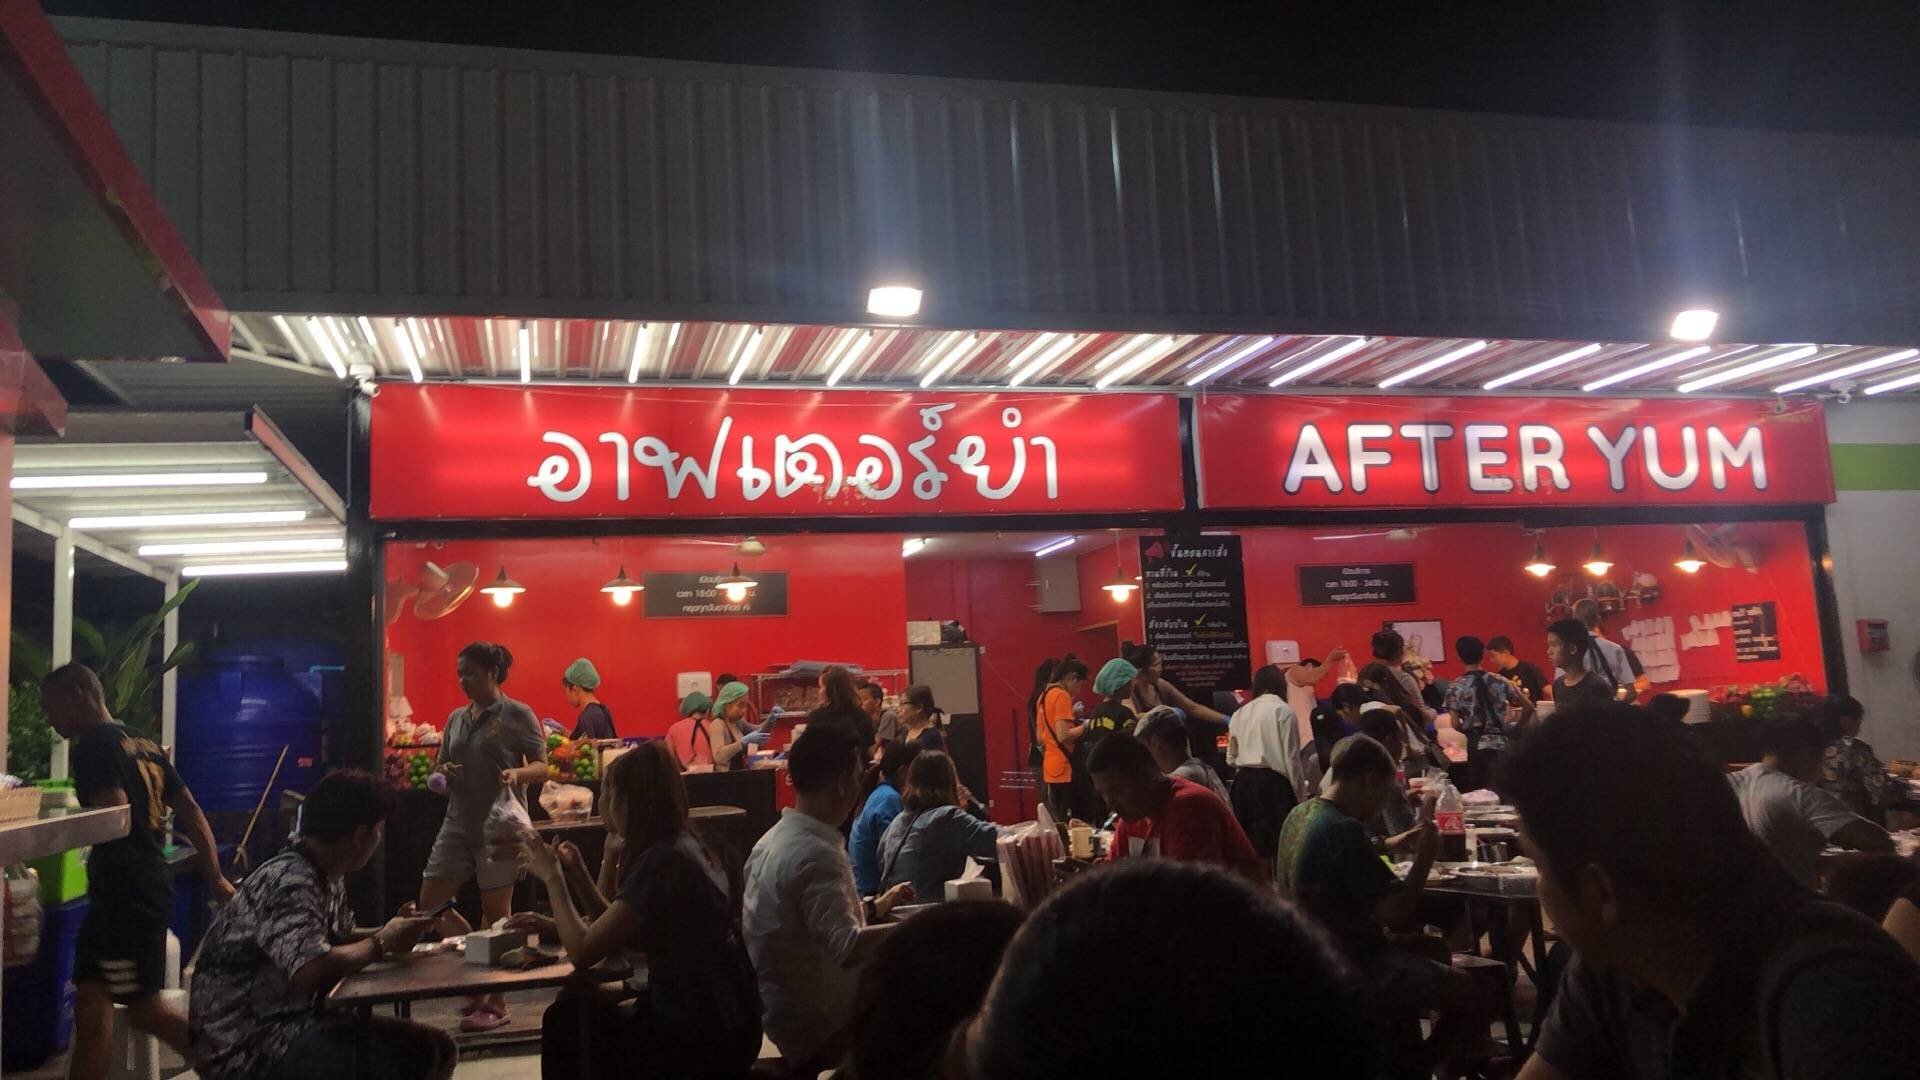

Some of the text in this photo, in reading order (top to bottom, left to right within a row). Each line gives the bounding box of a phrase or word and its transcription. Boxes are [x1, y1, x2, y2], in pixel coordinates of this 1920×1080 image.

[526, 402, 1059, 502] อาฟเตอร์ยำ
[1283, 422, 1769, 494] AFTER YUM
